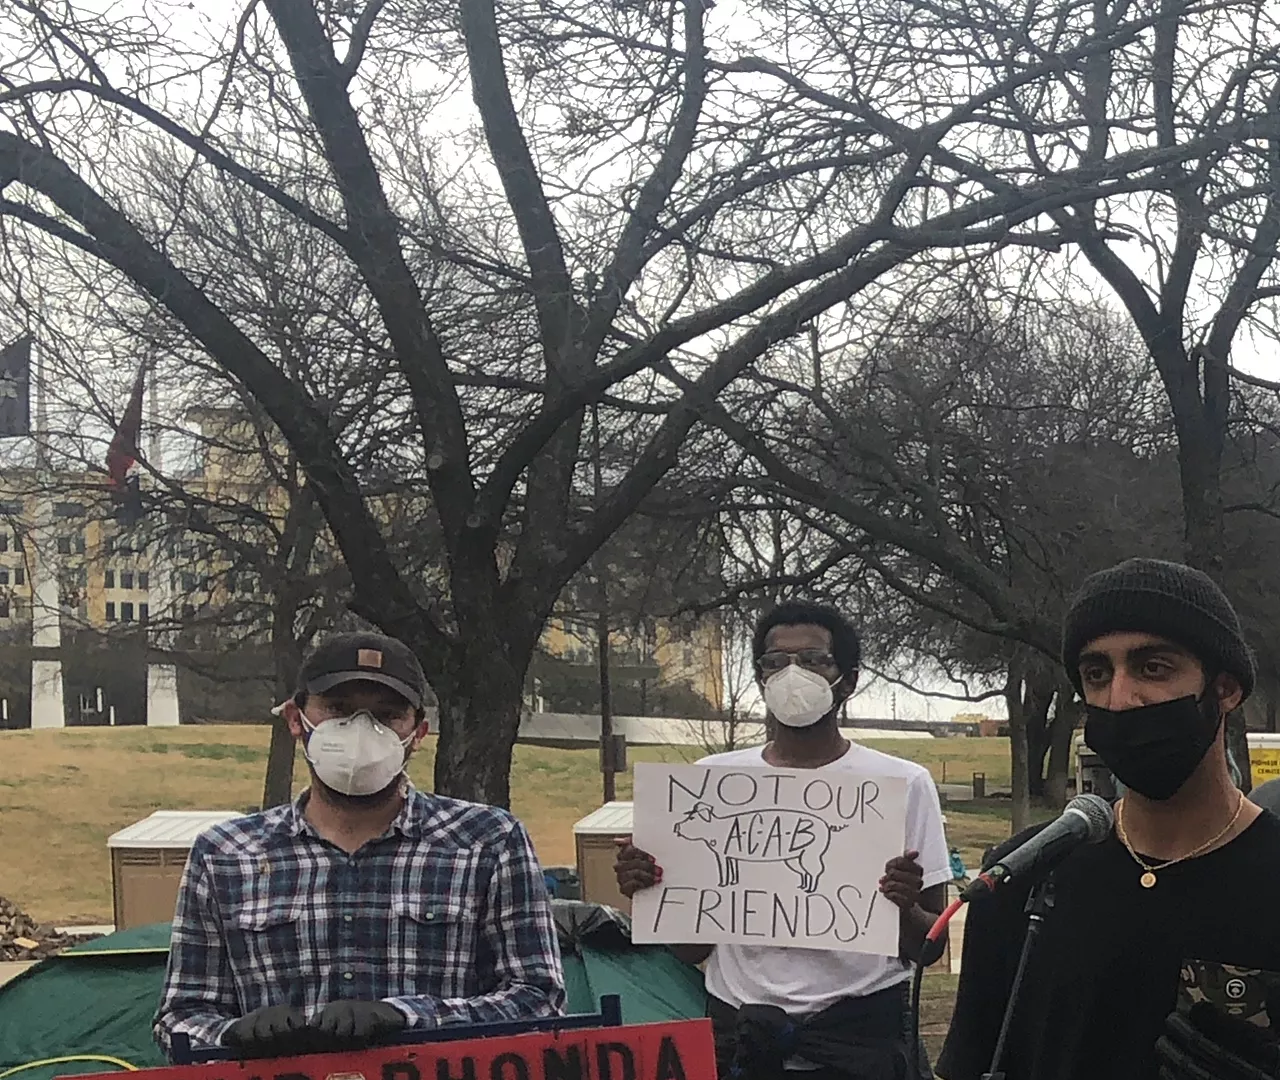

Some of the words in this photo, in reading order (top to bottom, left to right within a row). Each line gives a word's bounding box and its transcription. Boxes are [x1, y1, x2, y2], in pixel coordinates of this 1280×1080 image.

[669, 769, 796, 812] NOT
[804, 780, 884, 823] OUR
[653, 885, 877, 942] FRIENDS!
